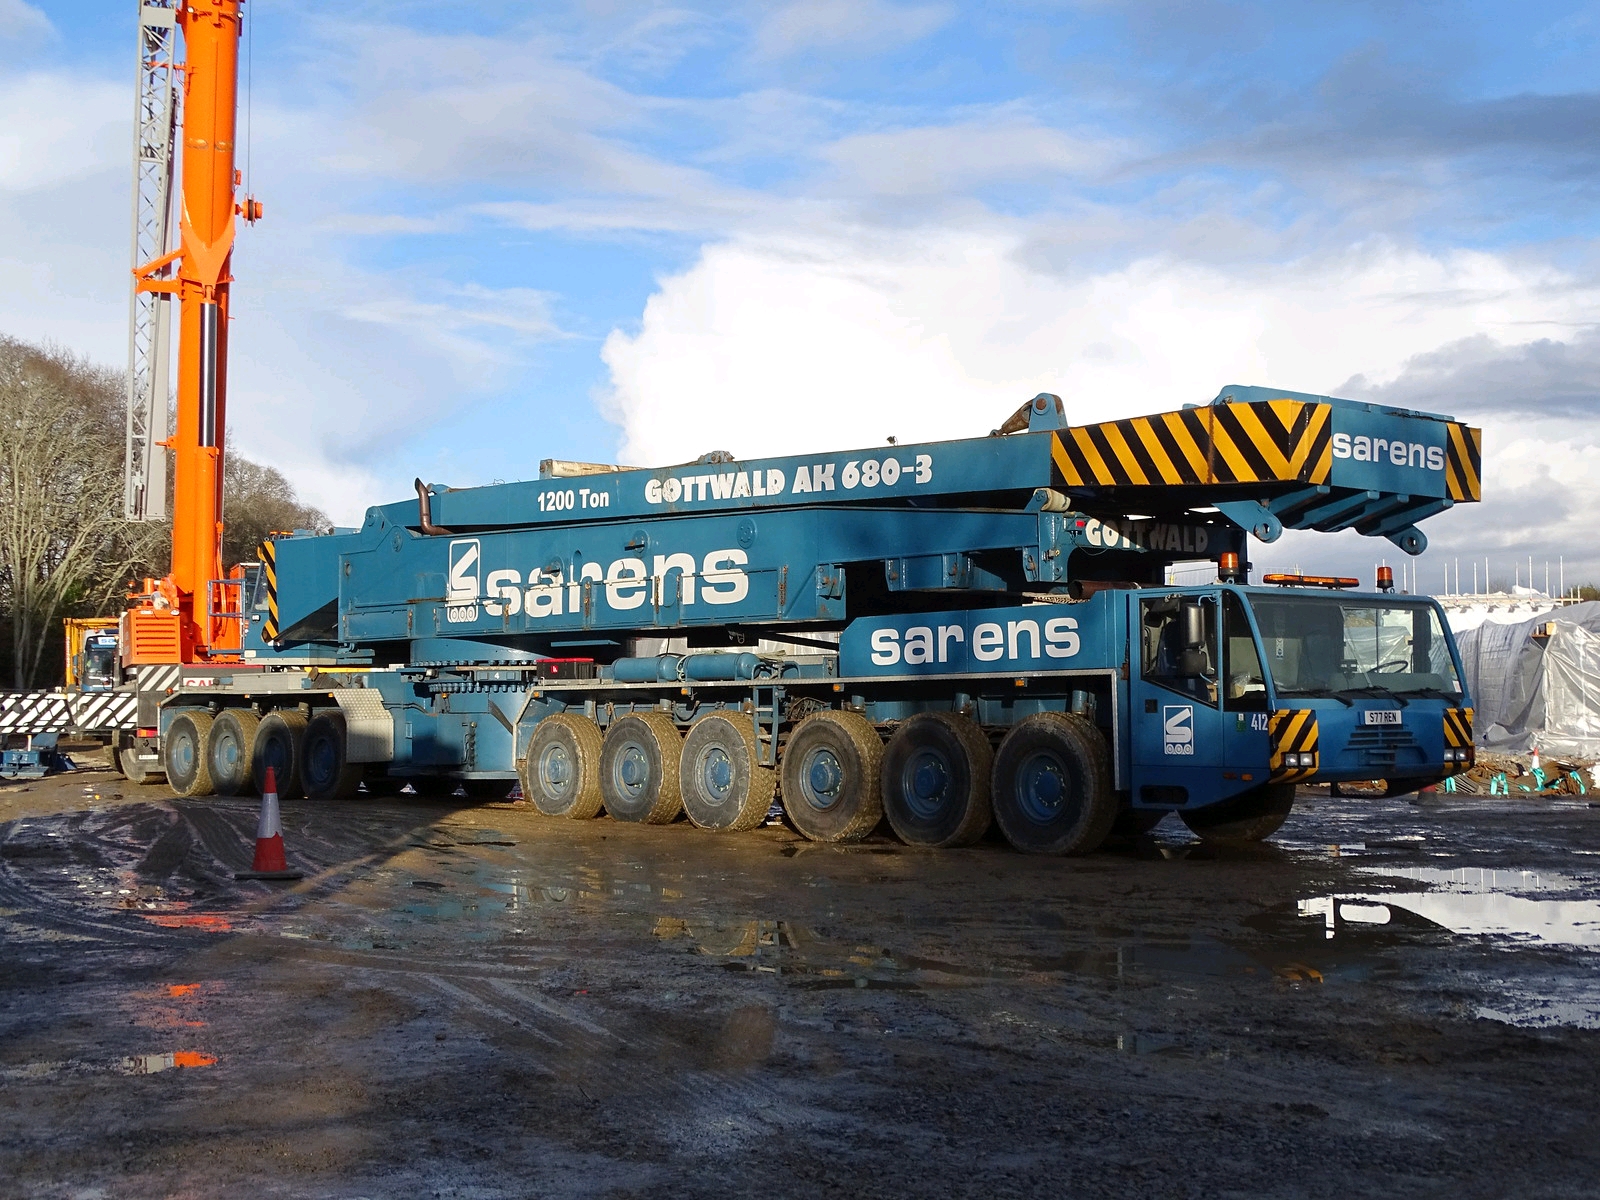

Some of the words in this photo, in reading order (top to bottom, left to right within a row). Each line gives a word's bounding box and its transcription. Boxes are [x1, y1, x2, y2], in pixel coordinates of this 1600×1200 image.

[1333, 433, 1444, 471] sarens
[644, 469, 785, 504] GOTTWALD
[792, 463, 836, 493] AK
[841, 454, 932, 489] 680-3
[538, 491, 574, 511] 1200
[579, 489, 609, 508] Ton
[1086, 518, 1208, 553] GOTTWALD
[485, 549, 749, 618] sarens
[871, 617, 1081, 665] sarens
[1251, 713, 1269, 731] 412
[1369, 712, 1383, 723] S77
[1384, 712, 1397, 722] REN
